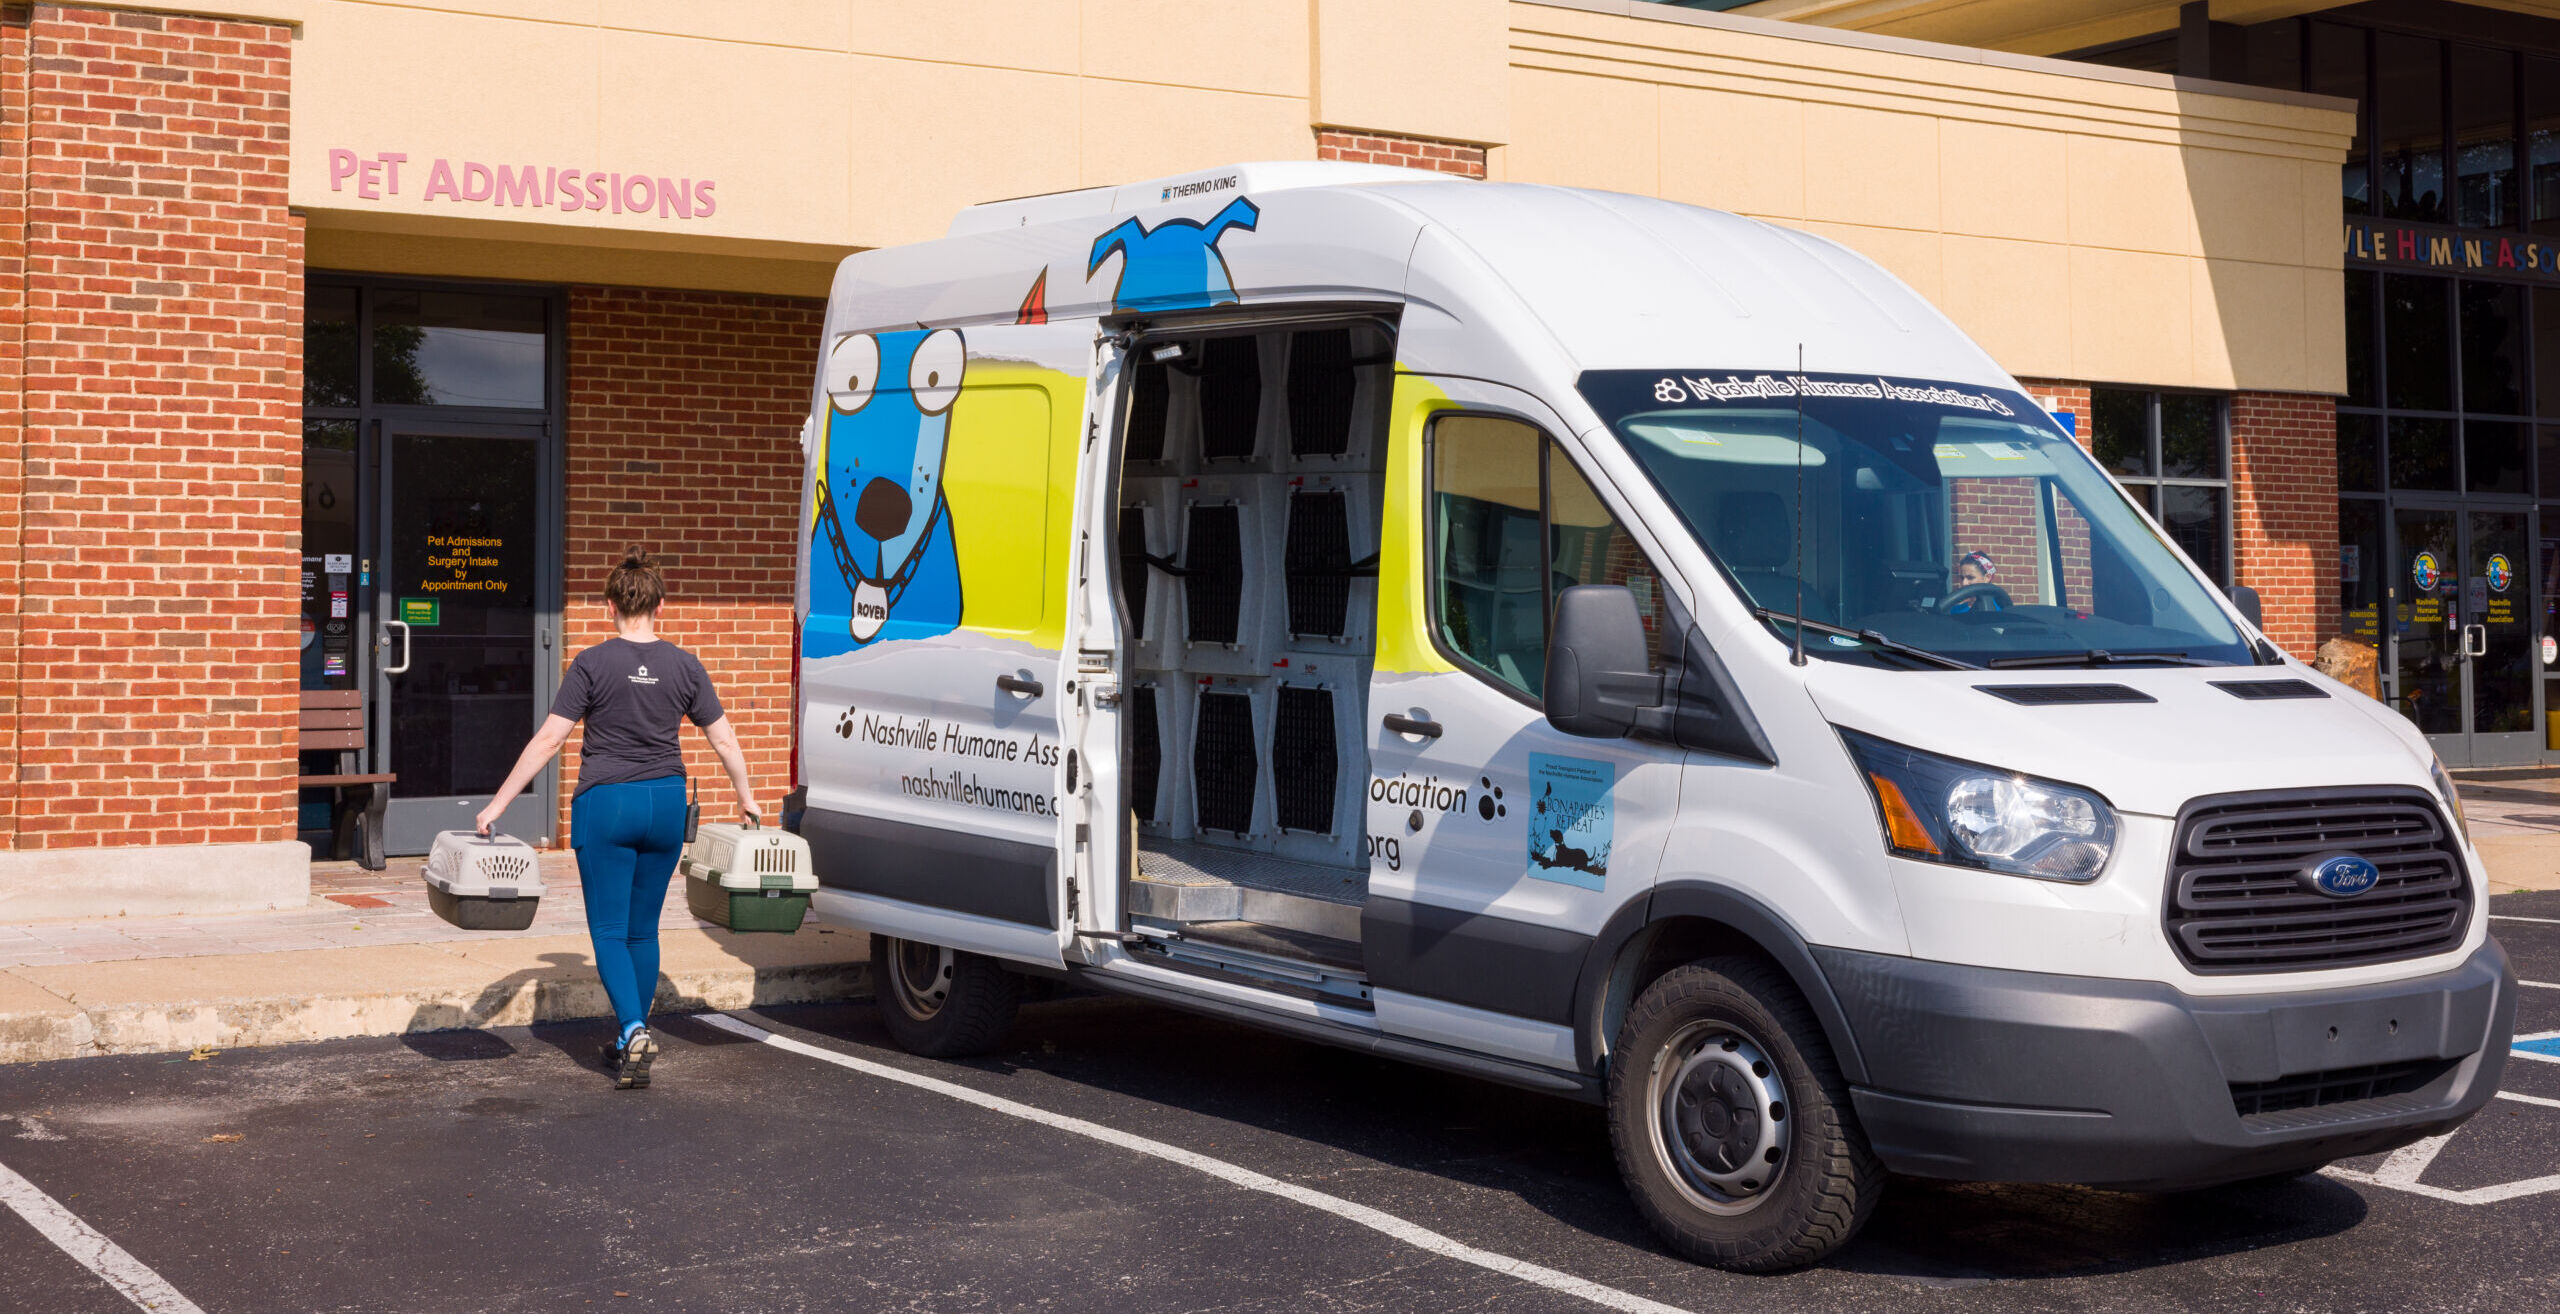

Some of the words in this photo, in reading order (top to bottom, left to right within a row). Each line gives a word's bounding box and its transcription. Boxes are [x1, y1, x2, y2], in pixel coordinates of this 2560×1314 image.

[328, 148, 408, 200] PET
[424, 158, 717, 219] ADMISSIONS
[1173, 181, 1212, 198] THERMO
[1213, 176, 1237, 191] KING
[2397, 229, 2493, 268] HUMANE
[2497, 237, 2560, 273] ASSO
[1682, 375, 1797, 402] Nashville
[1787, 376, 1883, 398] Humane
[1878, 377, 1993, 412] Association
[427, 535, 445, 547] Pet
[447, 535, 503, 547] Admissions
[452, 546, 471, 556] and
[428, 555, 467, 569] Surgery
[469, 556, 499, 566] Intake
[455, 568, 467, 581] by
[421, 580, 483, 592] Appointment
[485, 580, 508, 593] Only
[857, 601, 886, 620] ROVER
[862, 714, 937, 751] Nashville
[943, 723, 1017, 762] Humane
[1023, 733, 1060, 767] Ass
[1371, 771, 1467, 813] ociation
[1556, 814, 1593, 834] RETREAT
[2333, 864, 2368, 888] Ford
